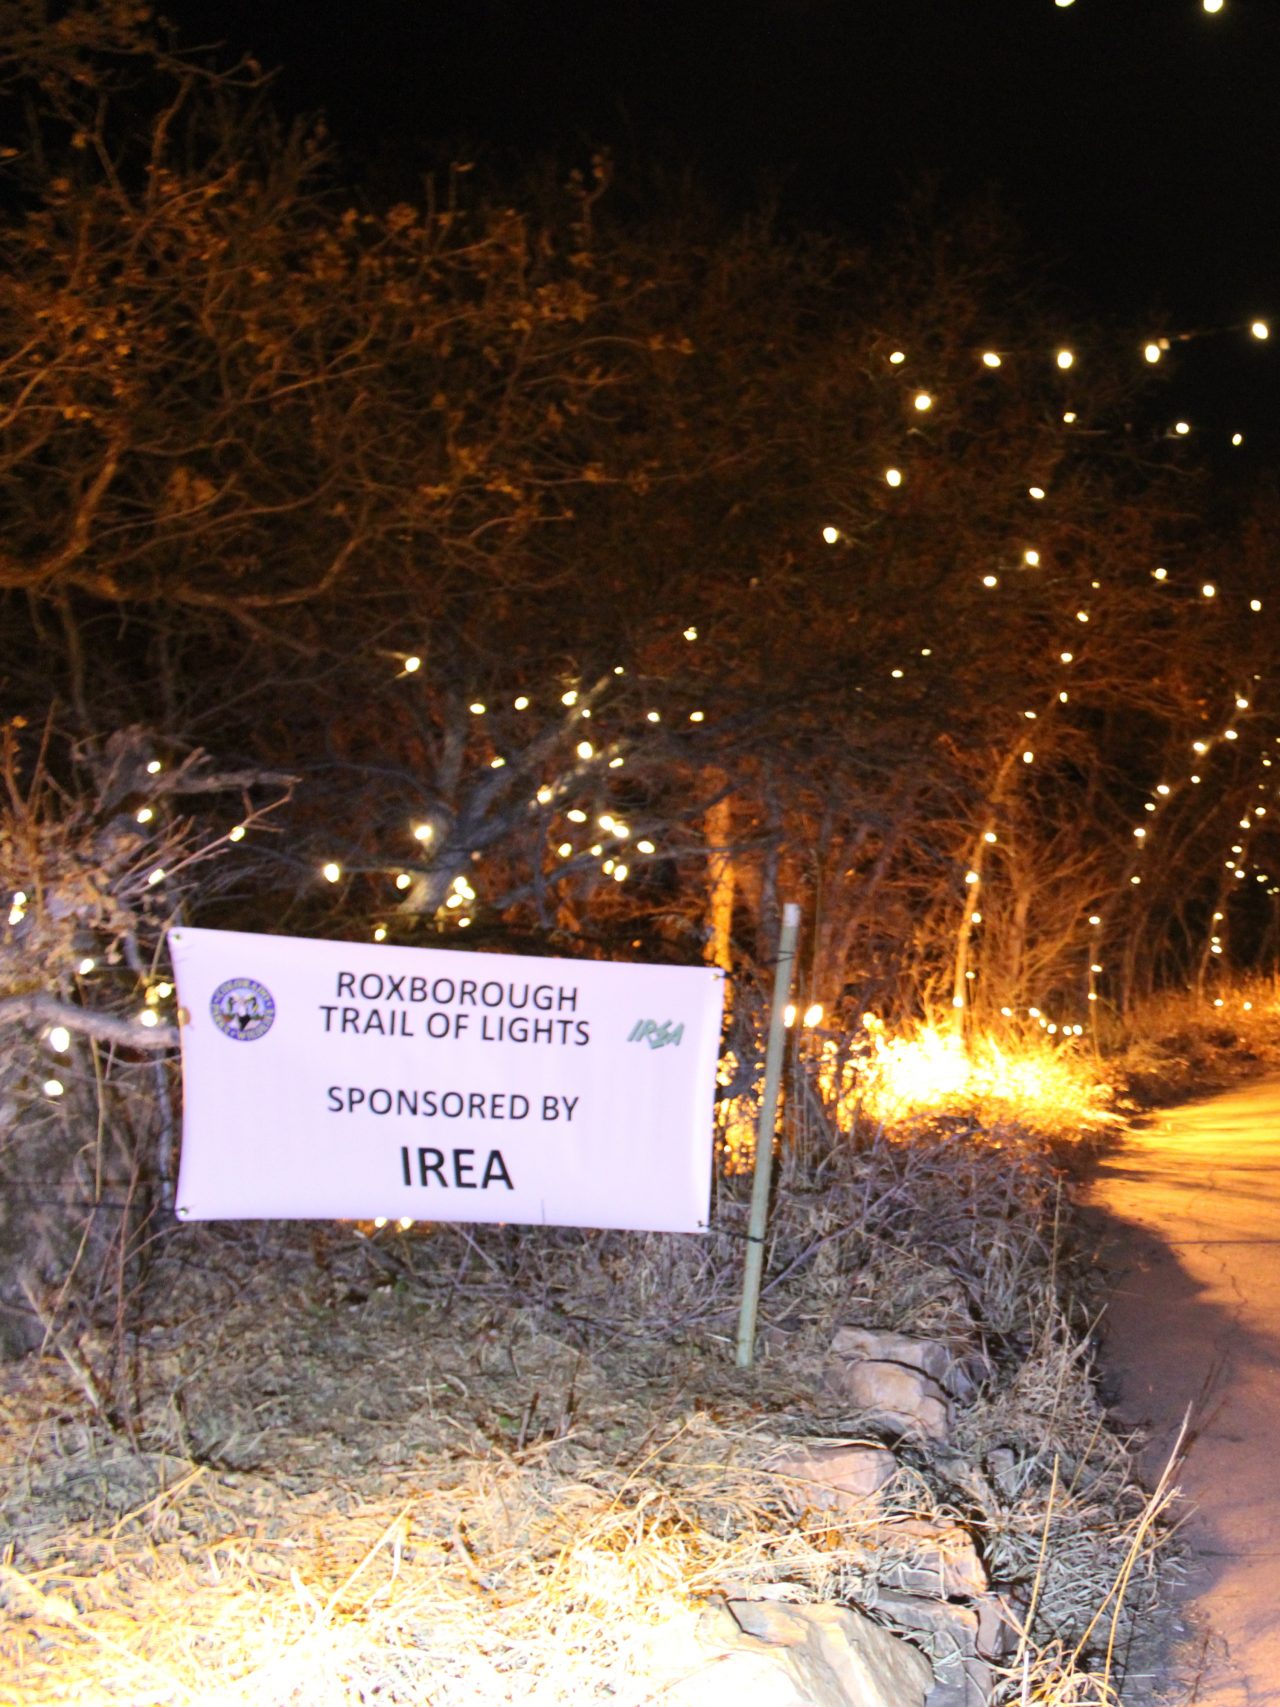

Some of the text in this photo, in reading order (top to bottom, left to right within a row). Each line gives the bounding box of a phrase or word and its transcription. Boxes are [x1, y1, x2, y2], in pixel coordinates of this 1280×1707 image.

[336, 971, 578, 1012] ROXBOROUGH
[319, 1005, 590, 1047] TRAIL OF LIGHTS
[327, 1085, 580, 1122] SPONSORED BY
[400, 1145, 515, 1191] IREA
